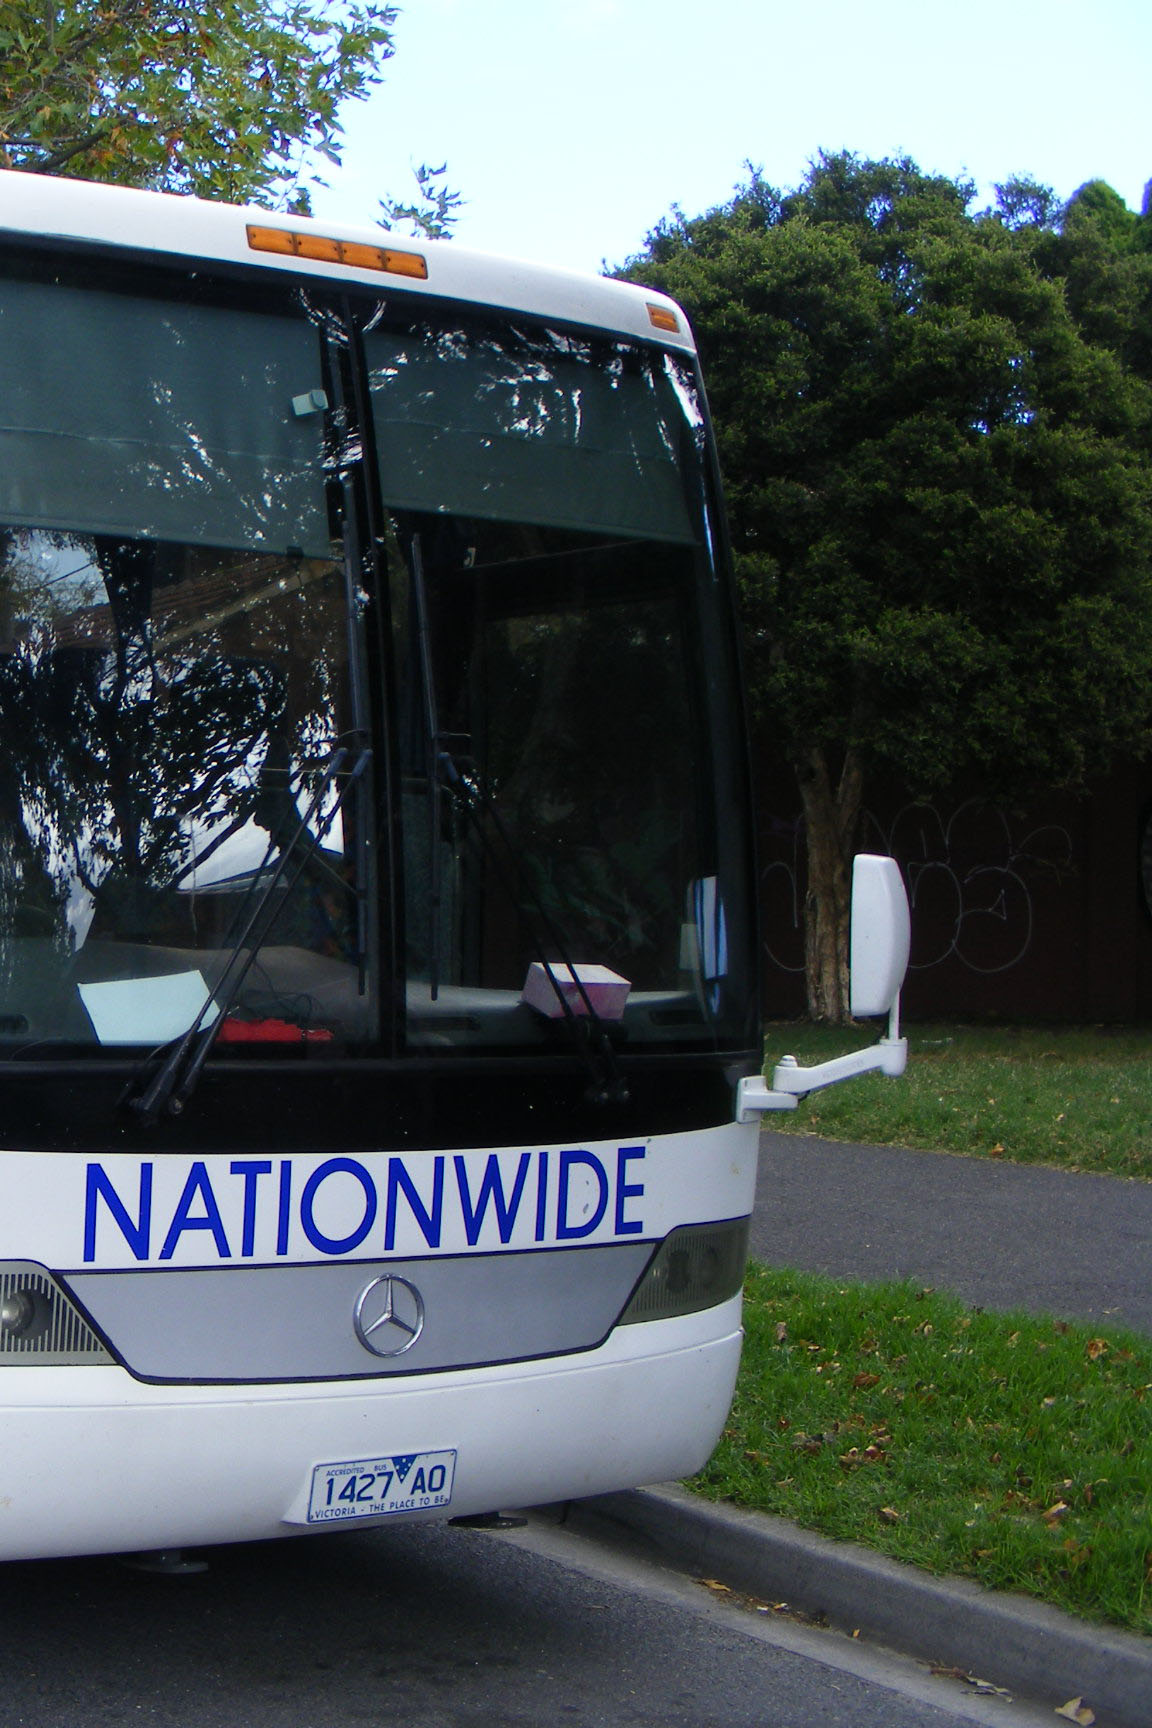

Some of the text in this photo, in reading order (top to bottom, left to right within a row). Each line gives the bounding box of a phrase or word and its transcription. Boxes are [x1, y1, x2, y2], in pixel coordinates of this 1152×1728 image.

[83, 1146, 647, 1262] NATIONWIDE
[325, 1464, 387, 1477] ACCREDITED BUS
[326, 1470, 394, 1506] 1427
[315, 1506, 356, 1519] VICTORIA
[369, 1503, 386, 1512] THE
[389, 1498, 415, 1511] PLACE
[419, 1496, 431, 1506] TO
[434, 1494, 445, 1504] BE
